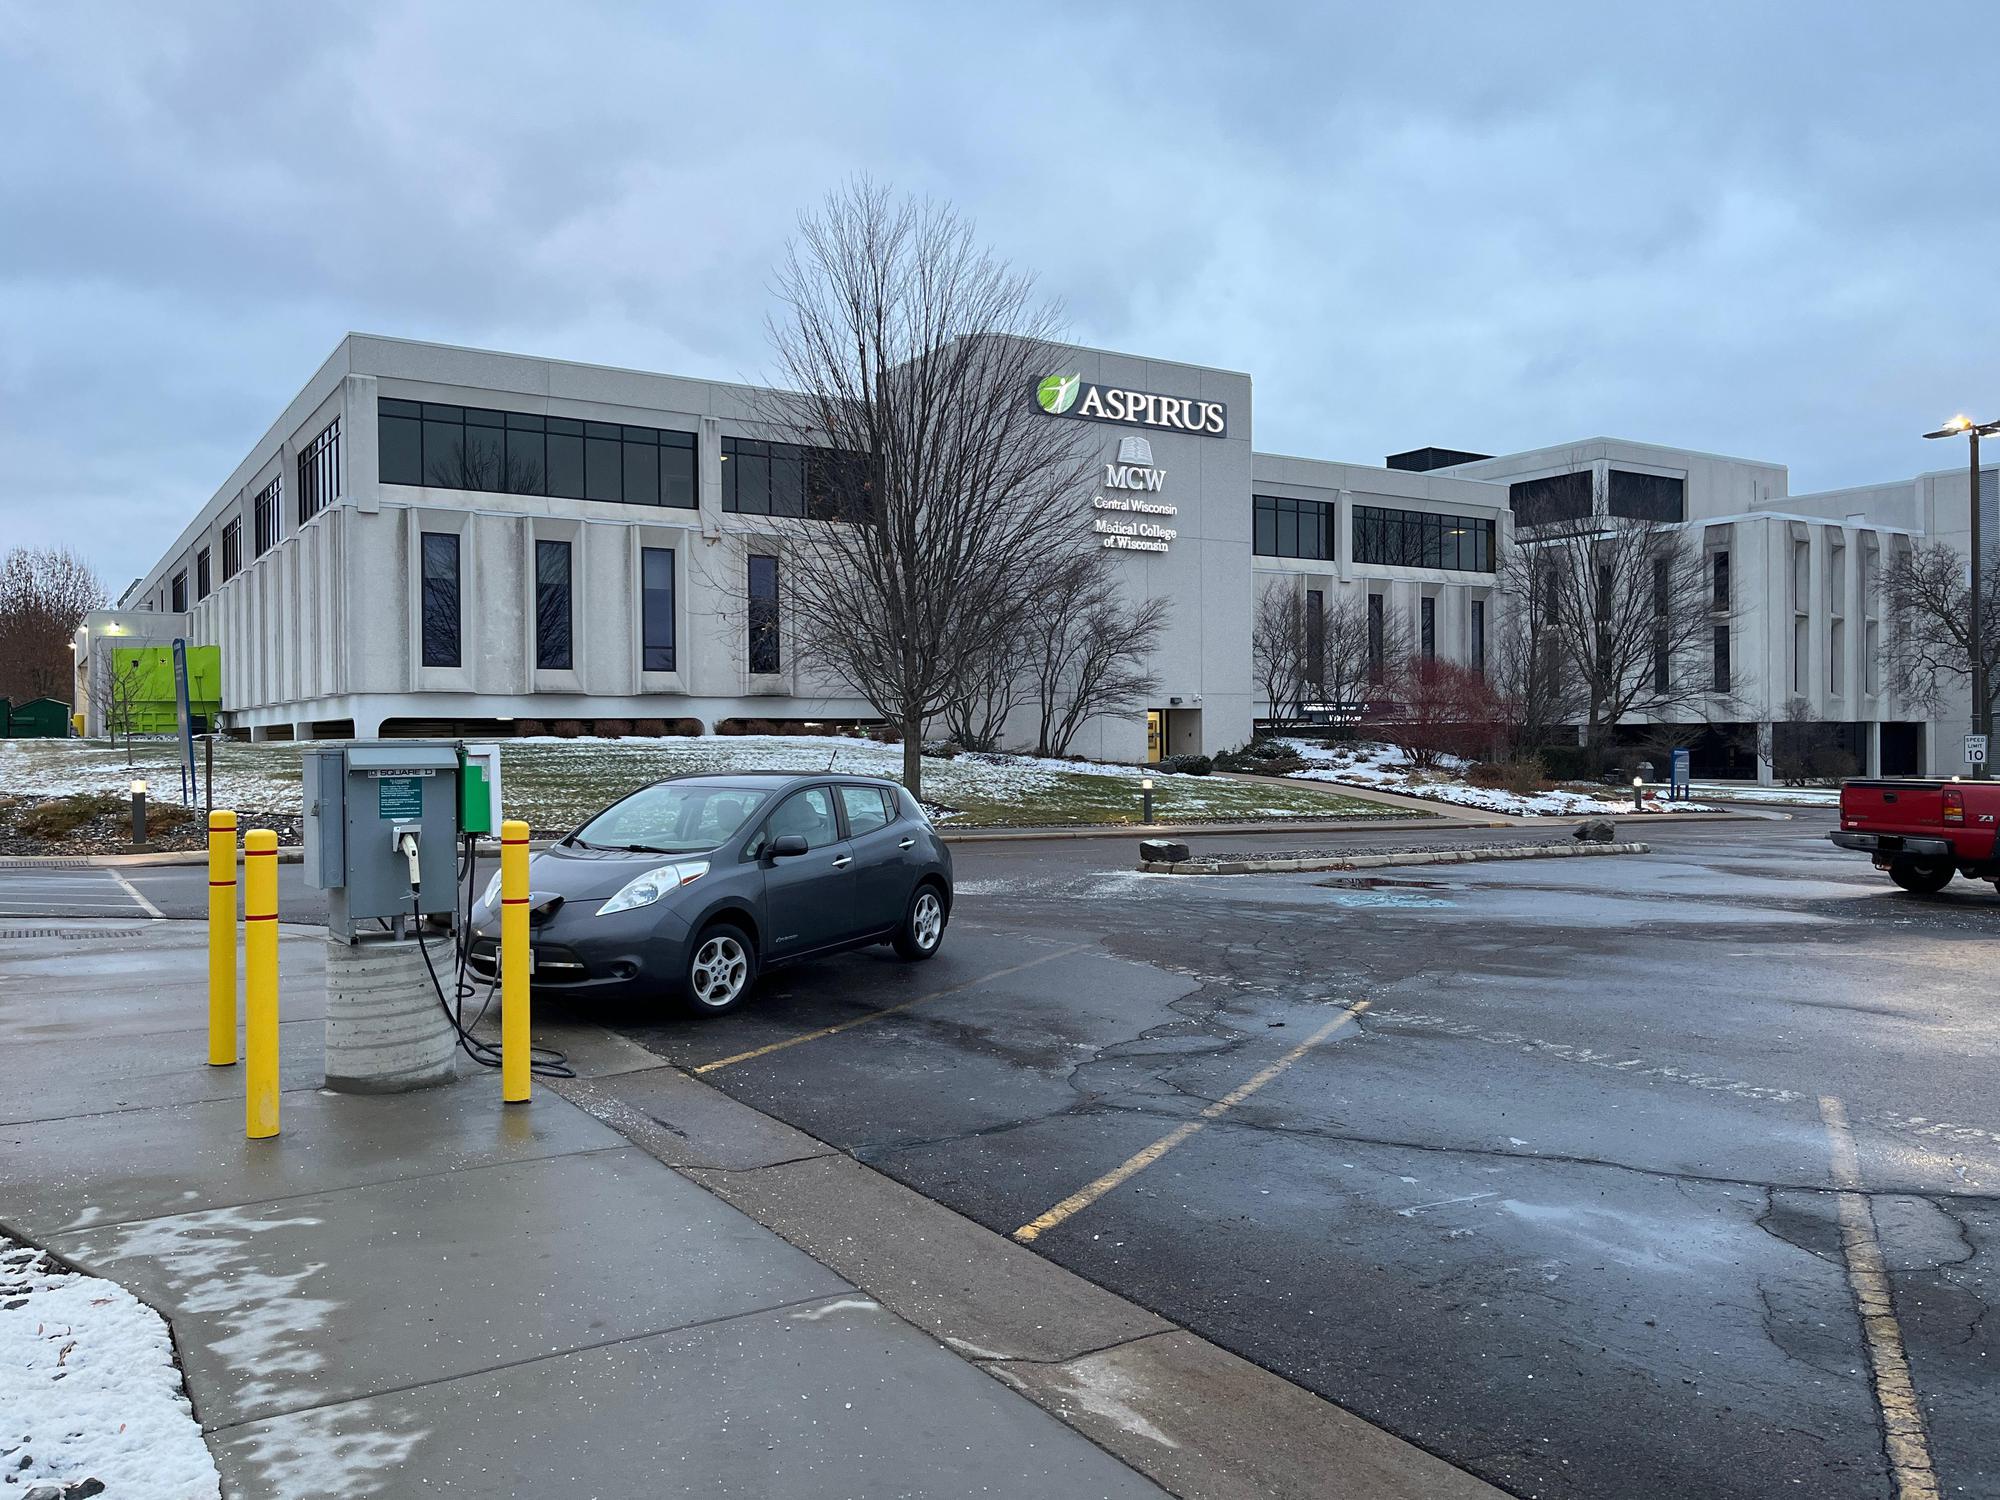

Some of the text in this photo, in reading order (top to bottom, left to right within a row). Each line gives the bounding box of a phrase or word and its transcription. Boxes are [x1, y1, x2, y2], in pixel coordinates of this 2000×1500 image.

[1078, 386, 1225, 433] ASPIRUS
[1105, 464, 1167, 492] MCW
[1094, 496, 1178, 515] Central Wisconsin
[1095, 519, 1177, 540] Medical College
[1103, 535, 1169, 552] of Wisconsin
[1968, 750, 1984, 761] 10
